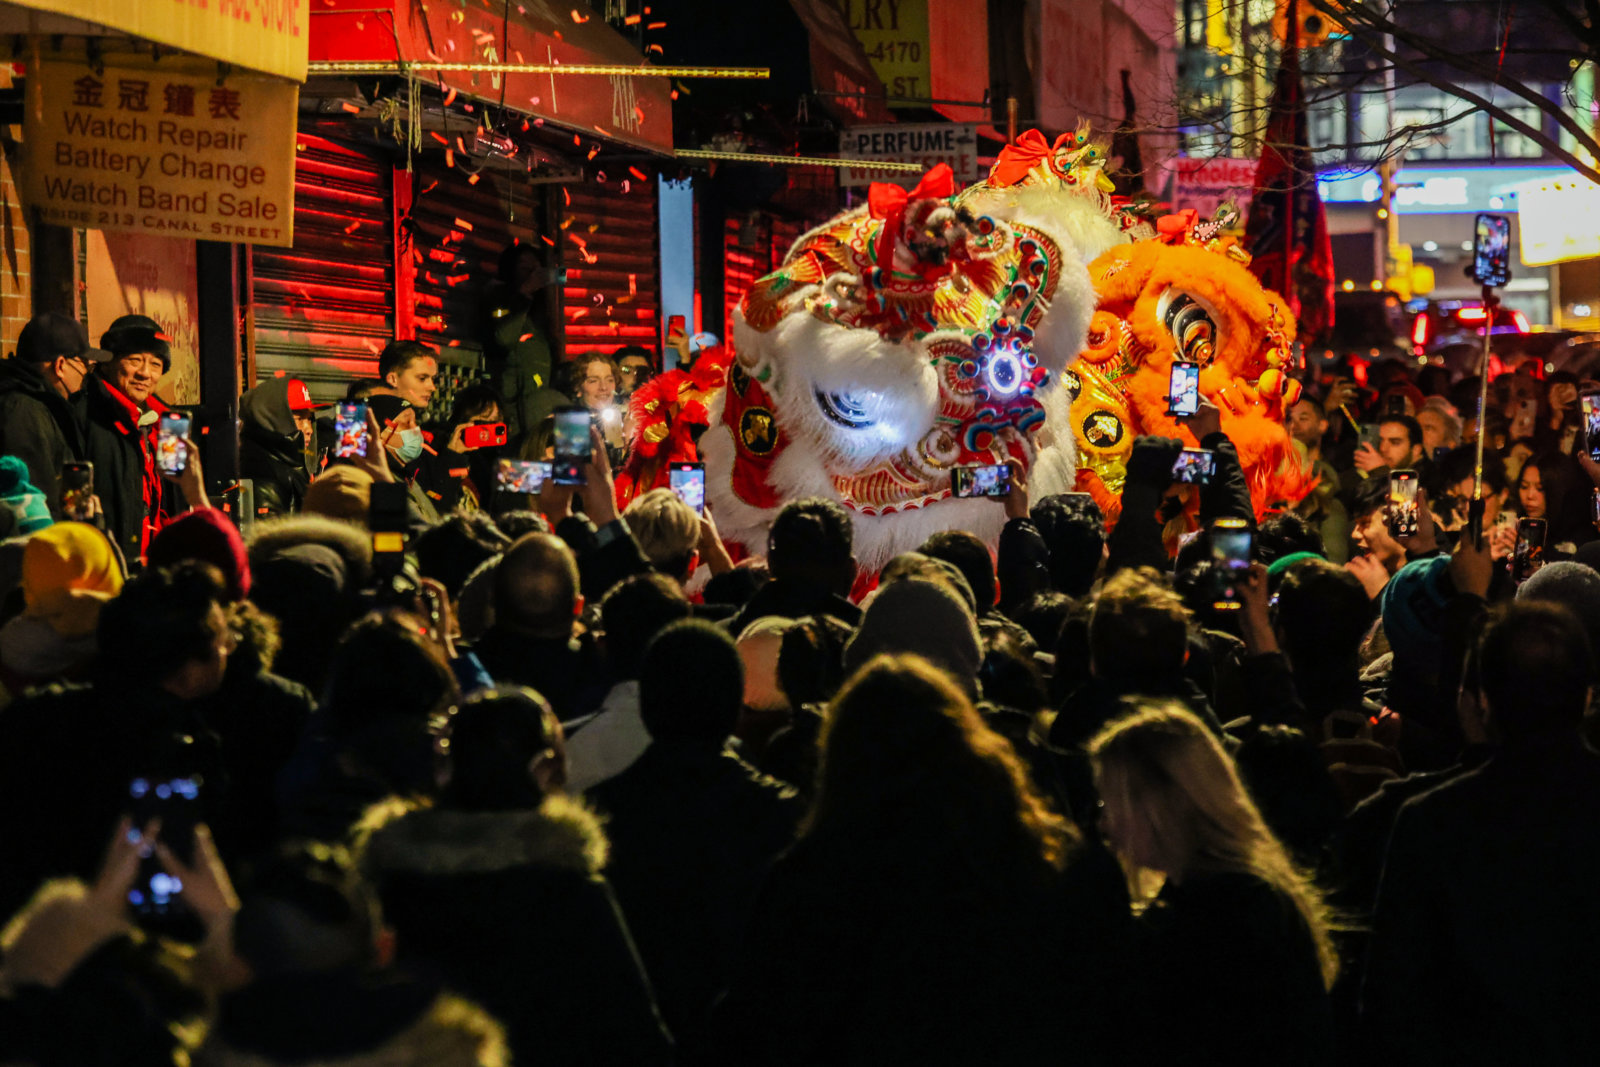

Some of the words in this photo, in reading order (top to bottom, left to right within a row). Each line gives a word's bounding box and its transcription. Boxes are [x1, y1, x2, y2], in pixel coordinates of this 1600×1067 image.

[64, 112, 147, 142] Watch
[157, 121, 248, 152] Repair
[858, 130, 955, 154] PERFUME
[55, 142, 150, 179] Battery
[160, 153, 266, 189] Change
[44, 174, 127, 206] Watch
[138, 185, 207, 214] Band
[217, 193, 278, 220] Sale
[37, 206, 90, 223] NSIDE
[97, 211, 135, 226] 213
[142, 216, 202, 233] CANAL
[211, 222, 282, 240] STREET
